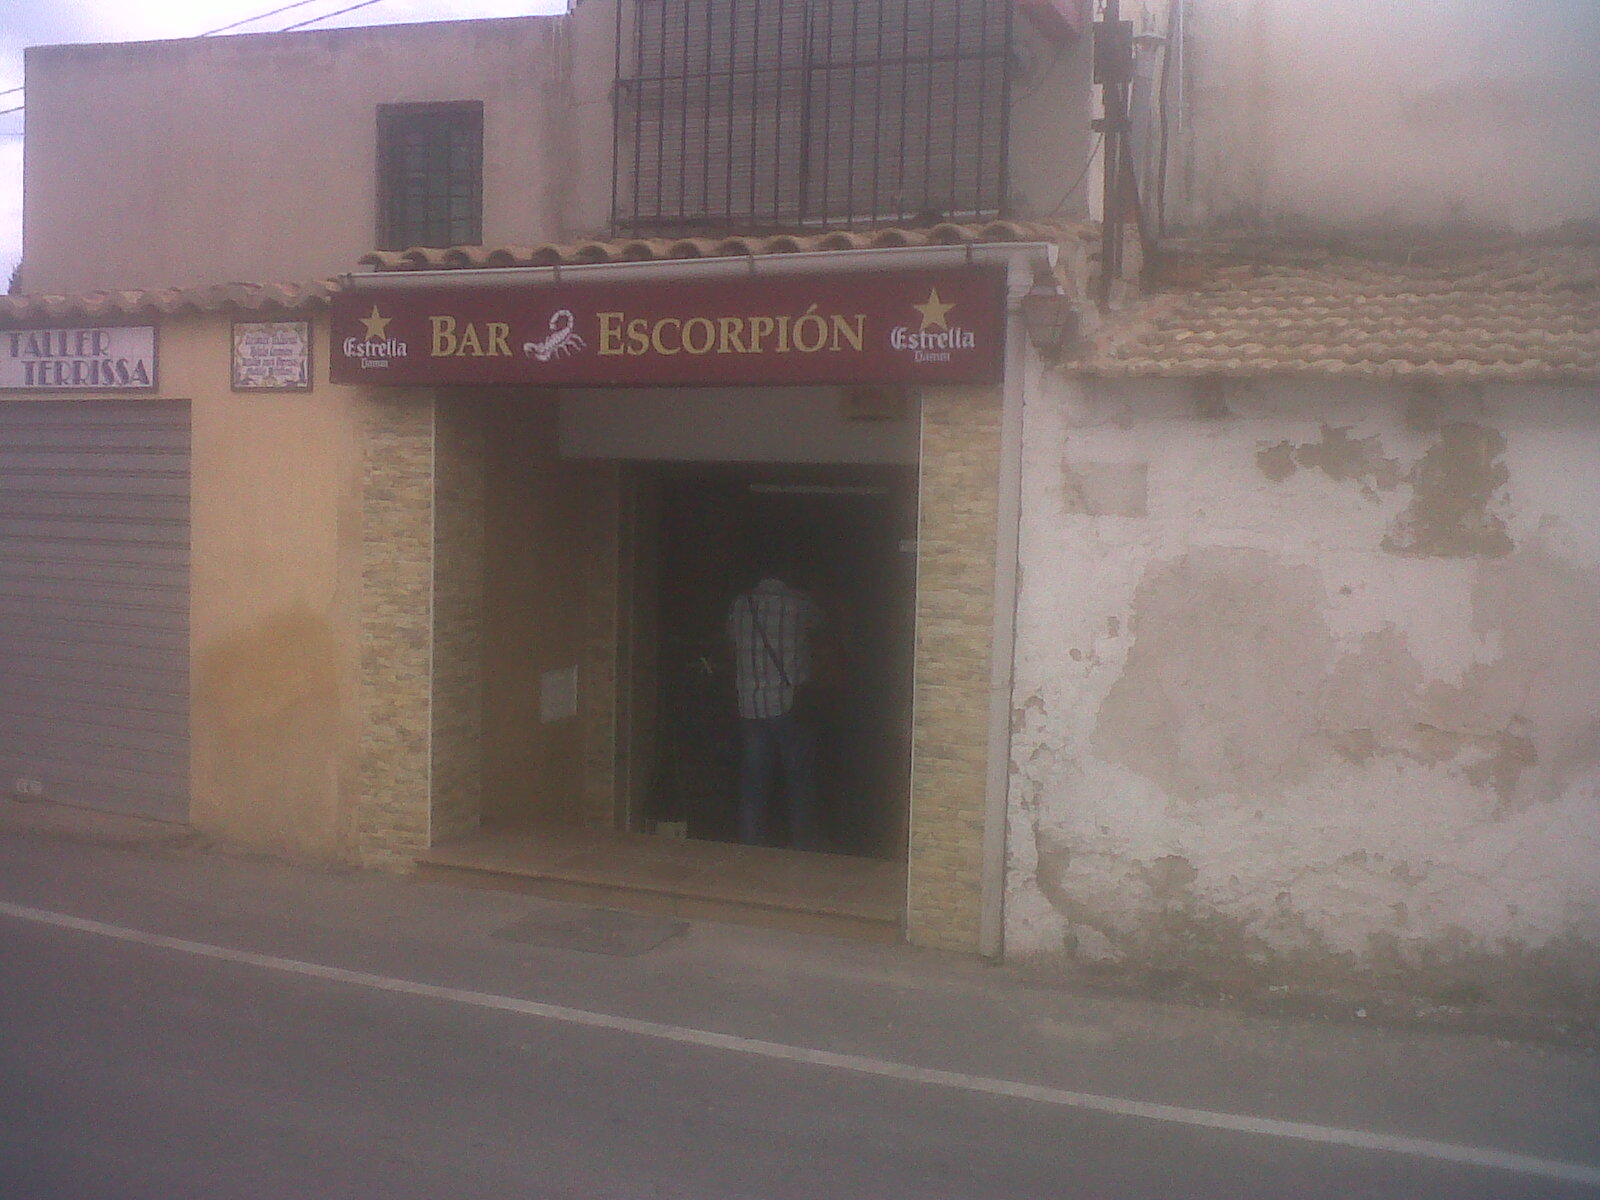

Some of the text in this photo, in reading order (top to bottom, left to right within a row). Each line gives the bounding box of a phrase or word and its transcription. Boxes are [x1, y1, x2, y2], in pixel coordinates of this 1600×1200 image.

[429, 303, 866, 357] BAR ESCORPIÓN
[890, 327, 976, 350] Estrella
[8, 331, 111, 358] TALLER
[343, 337, 407, 357] Estrella
[21, 359, 150, 386] TERRISSA
